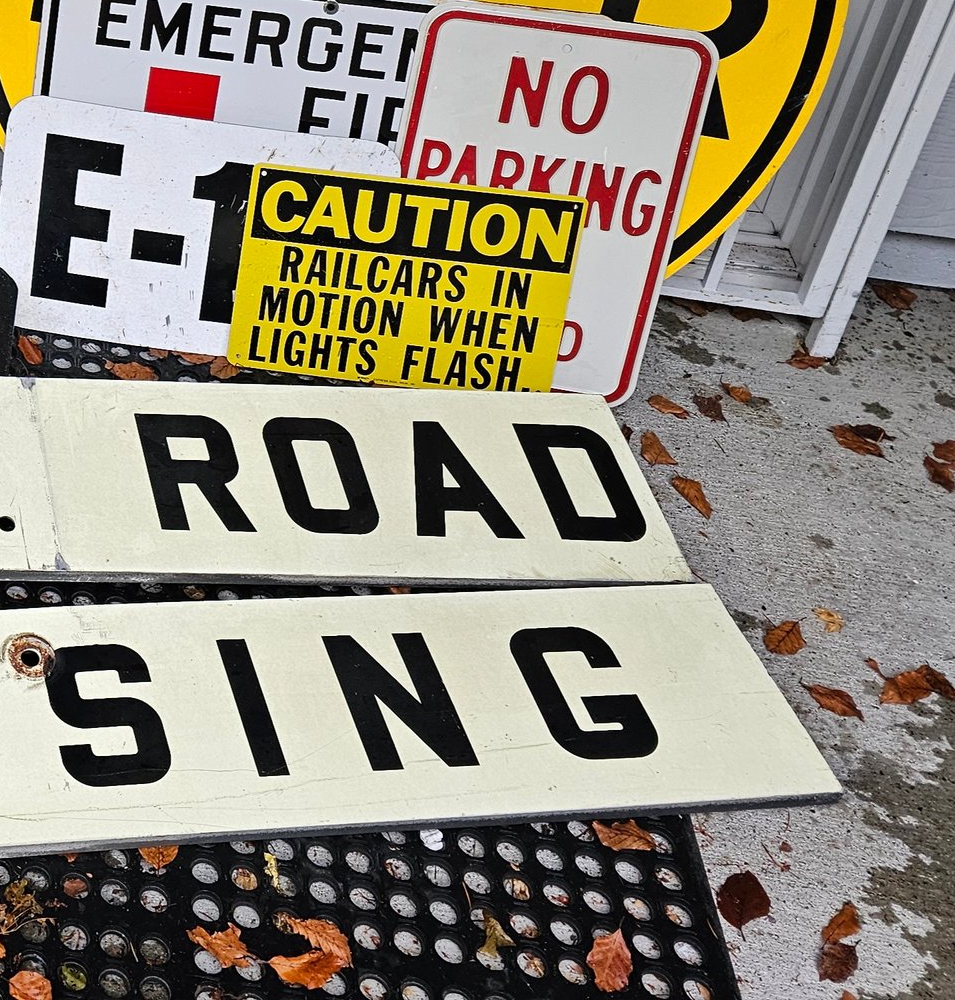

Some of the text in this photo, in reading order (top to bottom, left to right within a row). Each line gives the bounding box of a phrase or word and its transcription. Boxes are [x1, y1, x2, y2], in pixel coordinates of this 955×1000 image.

[497, 55, 610, 135] NO
[260, 179, 575, 264] CAUTION
[415, 138, 663, 237] PARKING
[279, 245, 532, 310] RAILCARS IN
[248, 324, 379, 376] LIGHTS
[258, 285, 405, 338] MOTION
[429, 305, 540, 354] WHEN
[135, 412, 648, 543] ROAD
